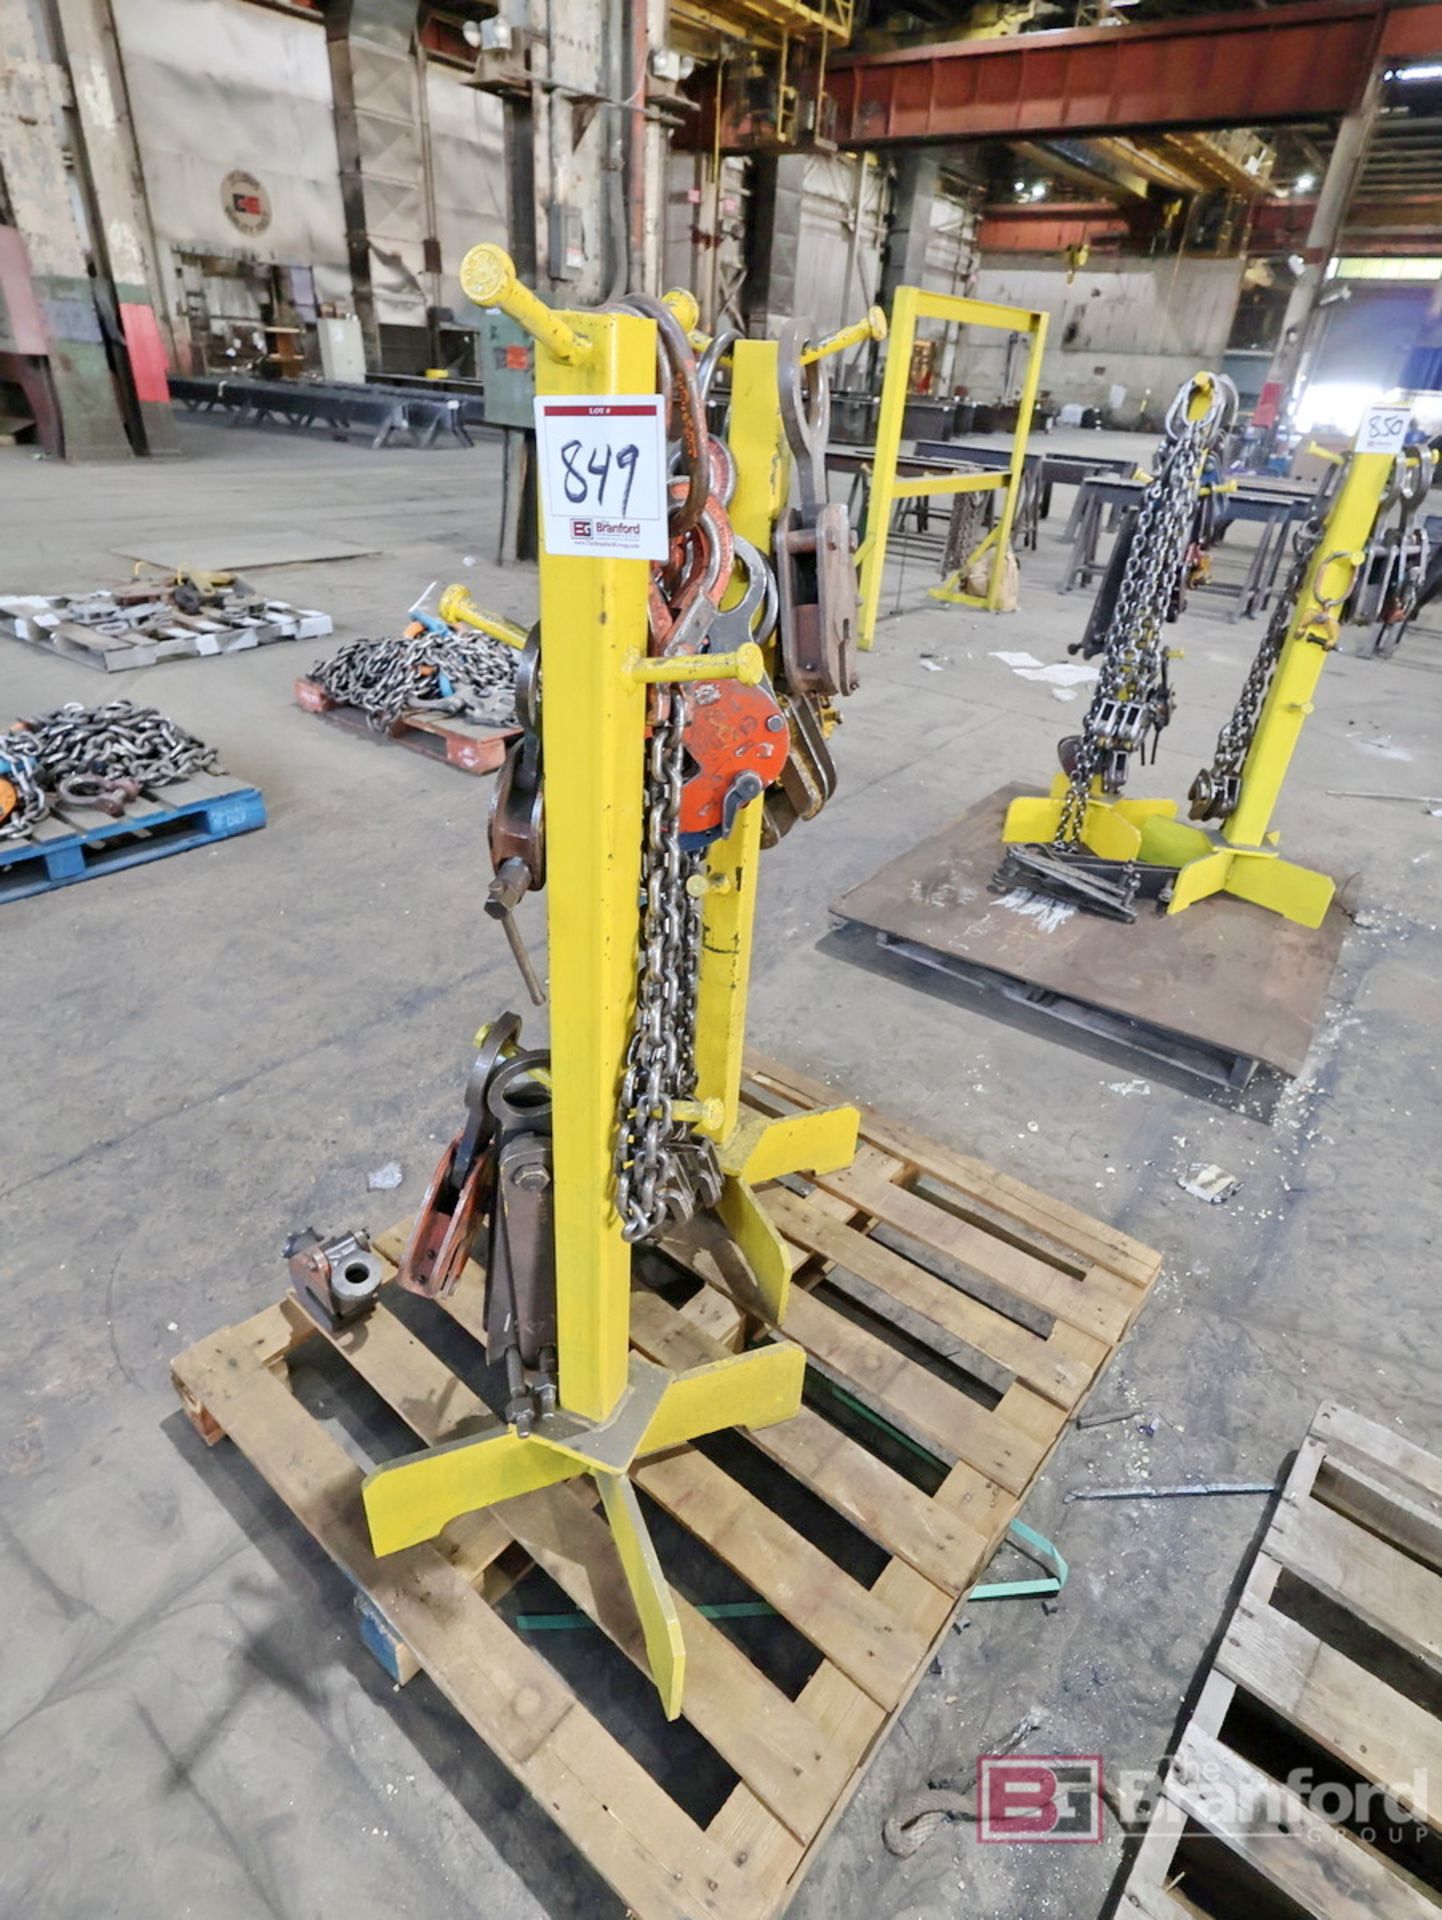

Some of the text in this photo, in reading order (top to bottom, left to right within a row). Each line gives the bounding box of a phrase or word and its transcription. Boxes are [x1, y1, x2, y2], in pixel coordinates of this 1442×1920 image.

[588, 407, 604, 415] LOT
[1368, 415, 1404, 439] 850
[561, 439, 640, 519] 849
[596, 522, 641, 535] Branford
